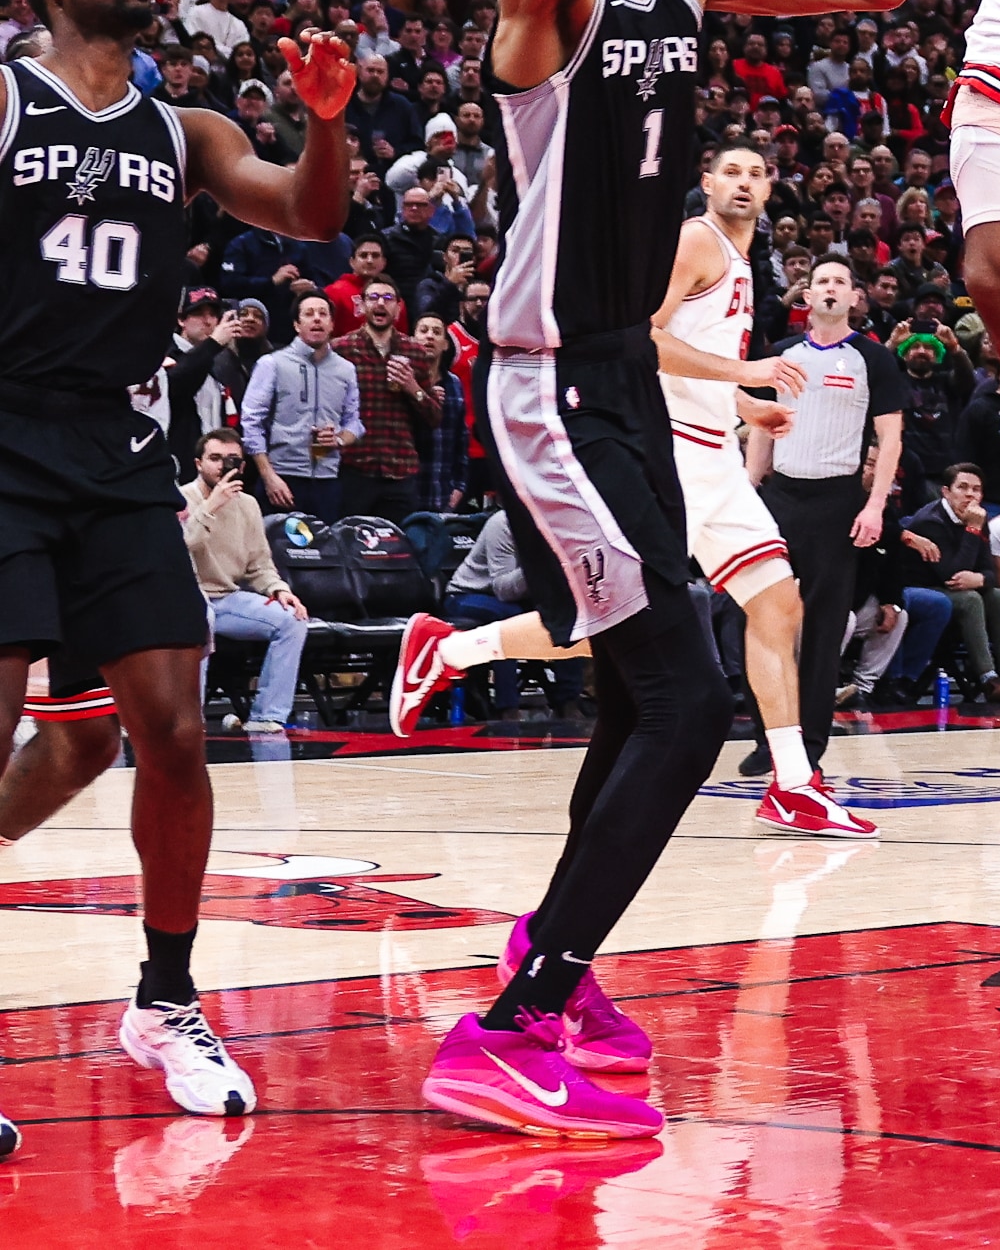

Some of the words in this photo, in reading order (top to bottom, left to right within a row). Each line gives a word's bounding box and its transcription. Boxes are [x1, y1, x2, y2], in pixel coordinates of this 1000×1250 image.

[602, 37, 698, 85] SPURS
[13, 144, 176, 204] SPURS
[638, 107, 666, 179] 1
[40, 213, 142, 291] 40
